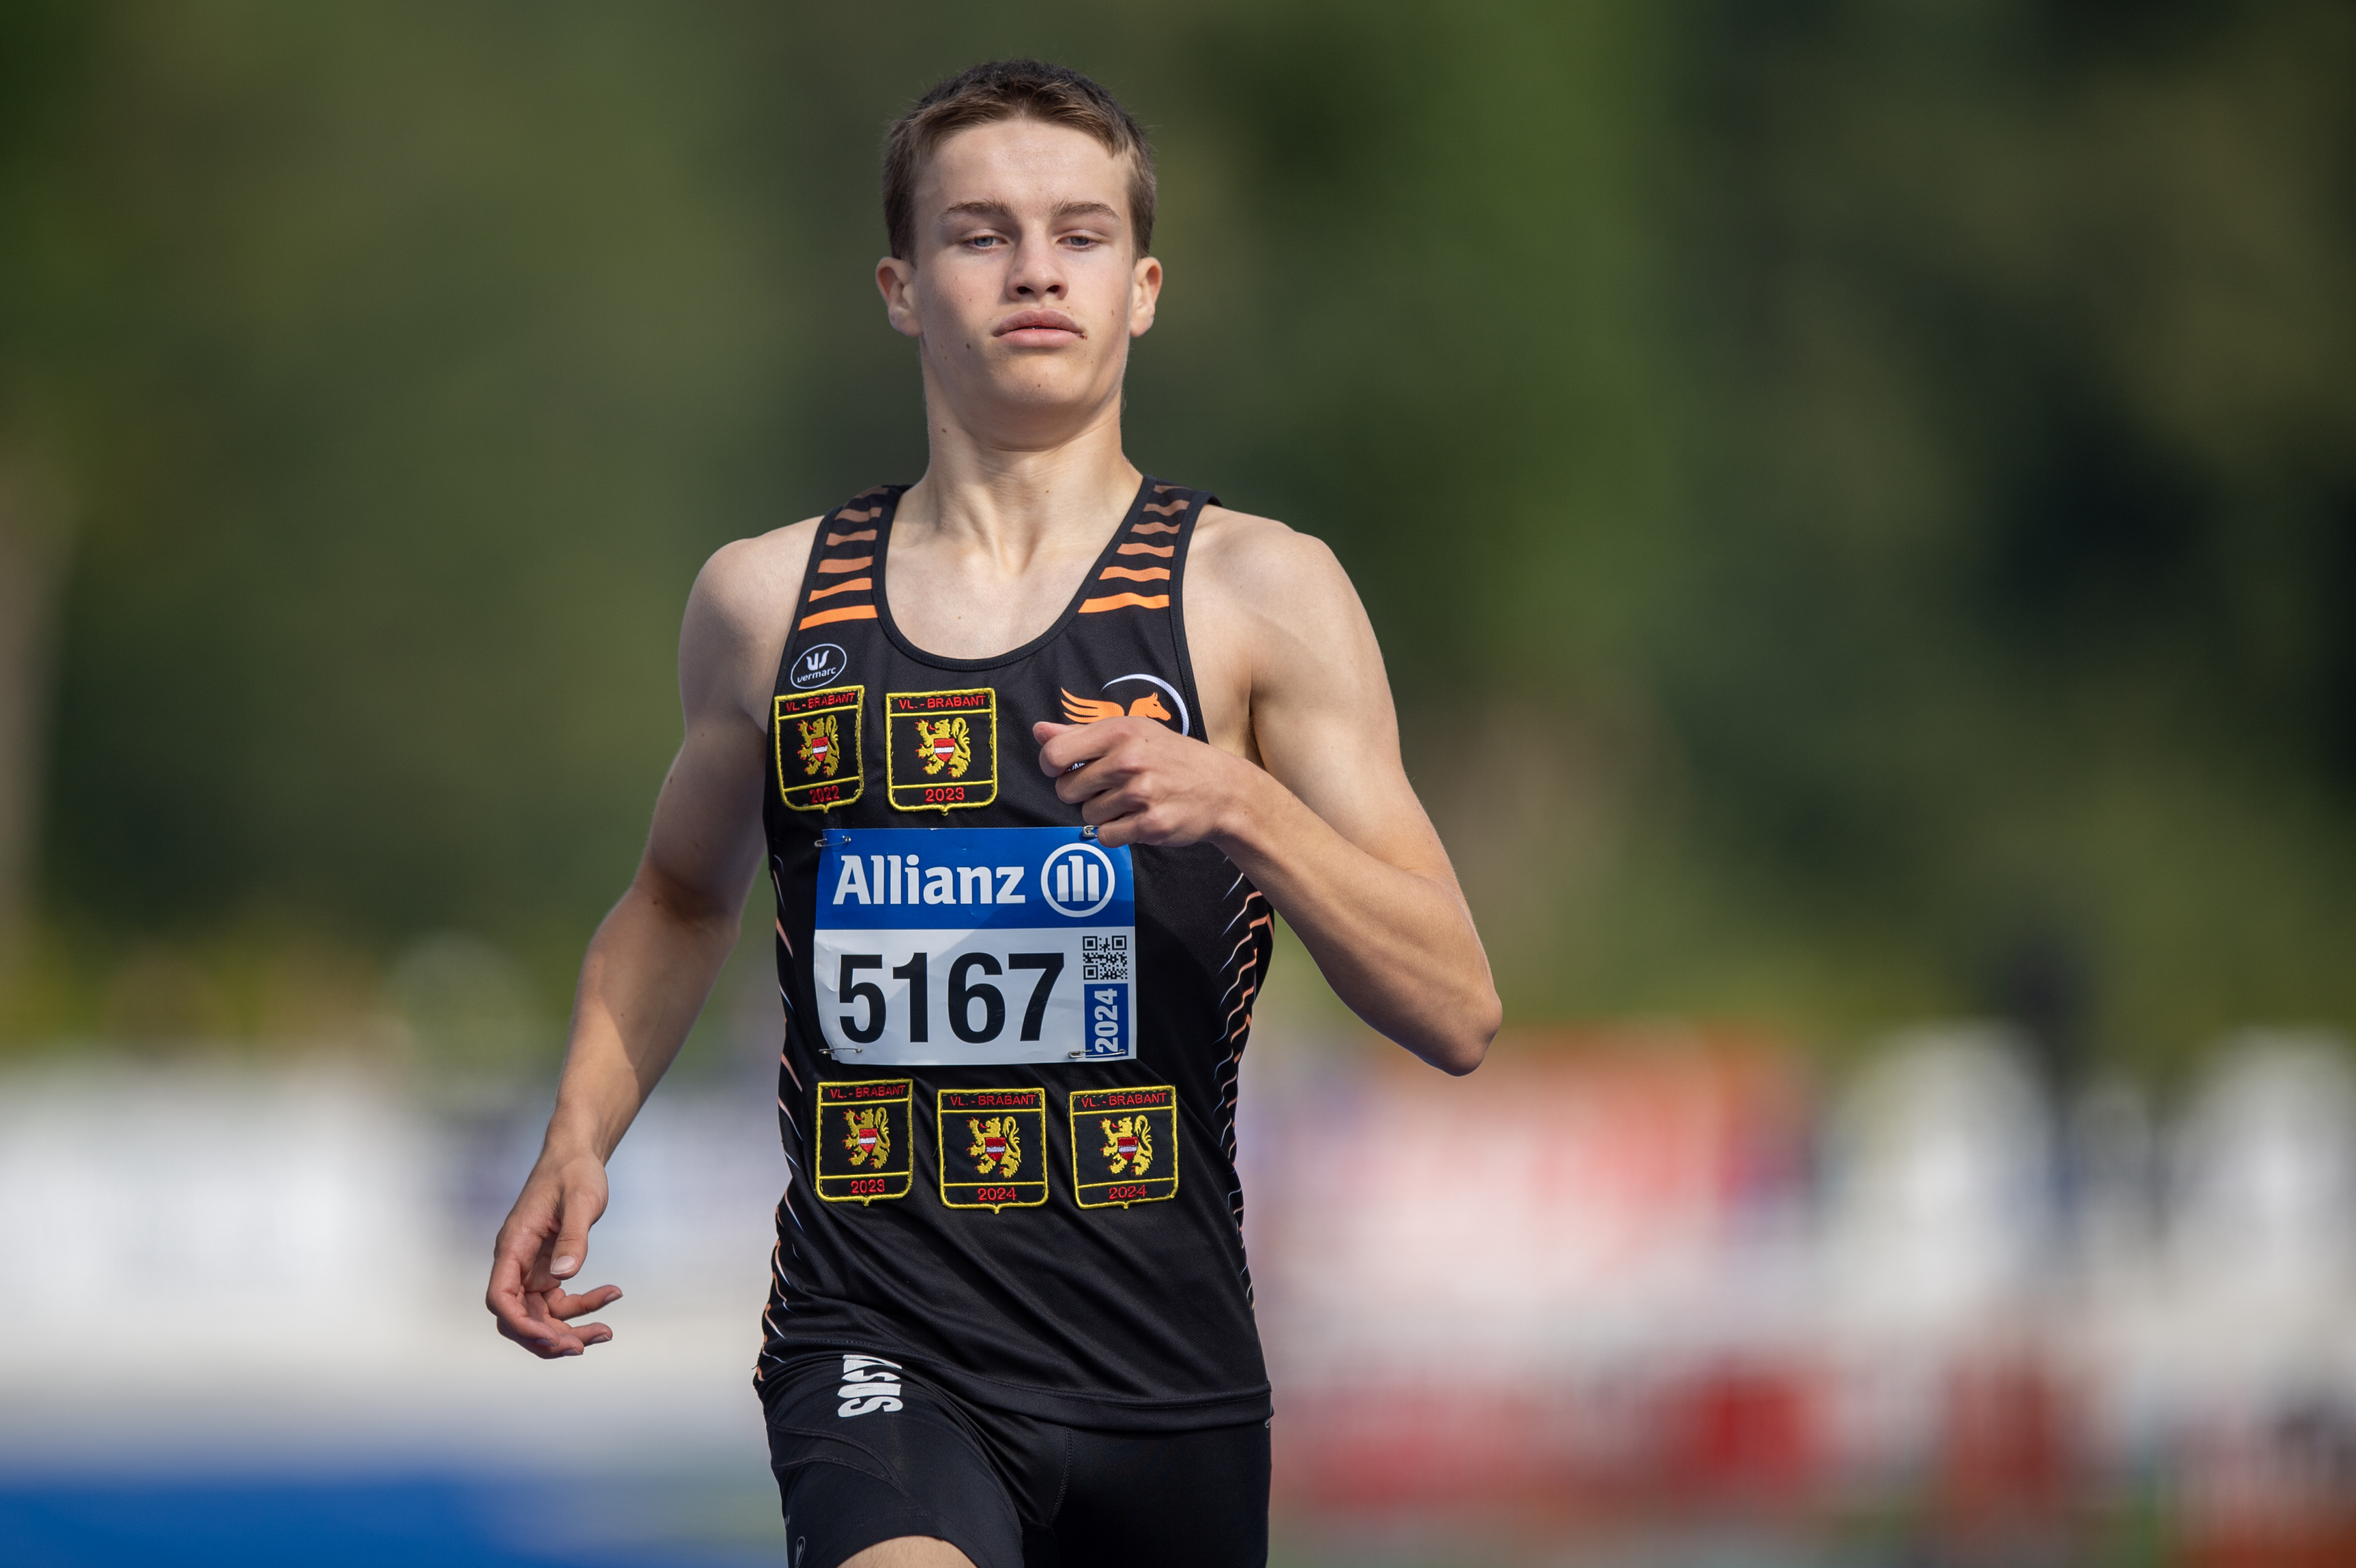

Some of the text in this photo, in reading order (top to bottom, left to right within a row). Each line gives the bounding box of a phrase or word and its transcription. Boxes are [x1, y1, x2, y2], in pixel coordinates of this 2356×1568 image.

[797, 667, 837, 683] vermarc
[808, 692, 855, 709] BRABANT
[927, 695, 986, 709] BRABANT
[809, 785, 840, 804] 2022
[925, 786, 965, 803] 2023
[832, 854, 1026, 905] Allianz
[839, 952, 1065, 1044] 5167
[1094, 988, 1118, 1053] 2024
[855, 1085, 906, 1098] BRABANT
[1109, 1092, 1167, 1106] BRABANT
[978, 1094, 1036, 1106] BRABANT
[850, 1179, 885, 1194] 2023
[977, 1187, 1016, 1201] 2024
[1109, 1184, 1147, 1200] 2024
